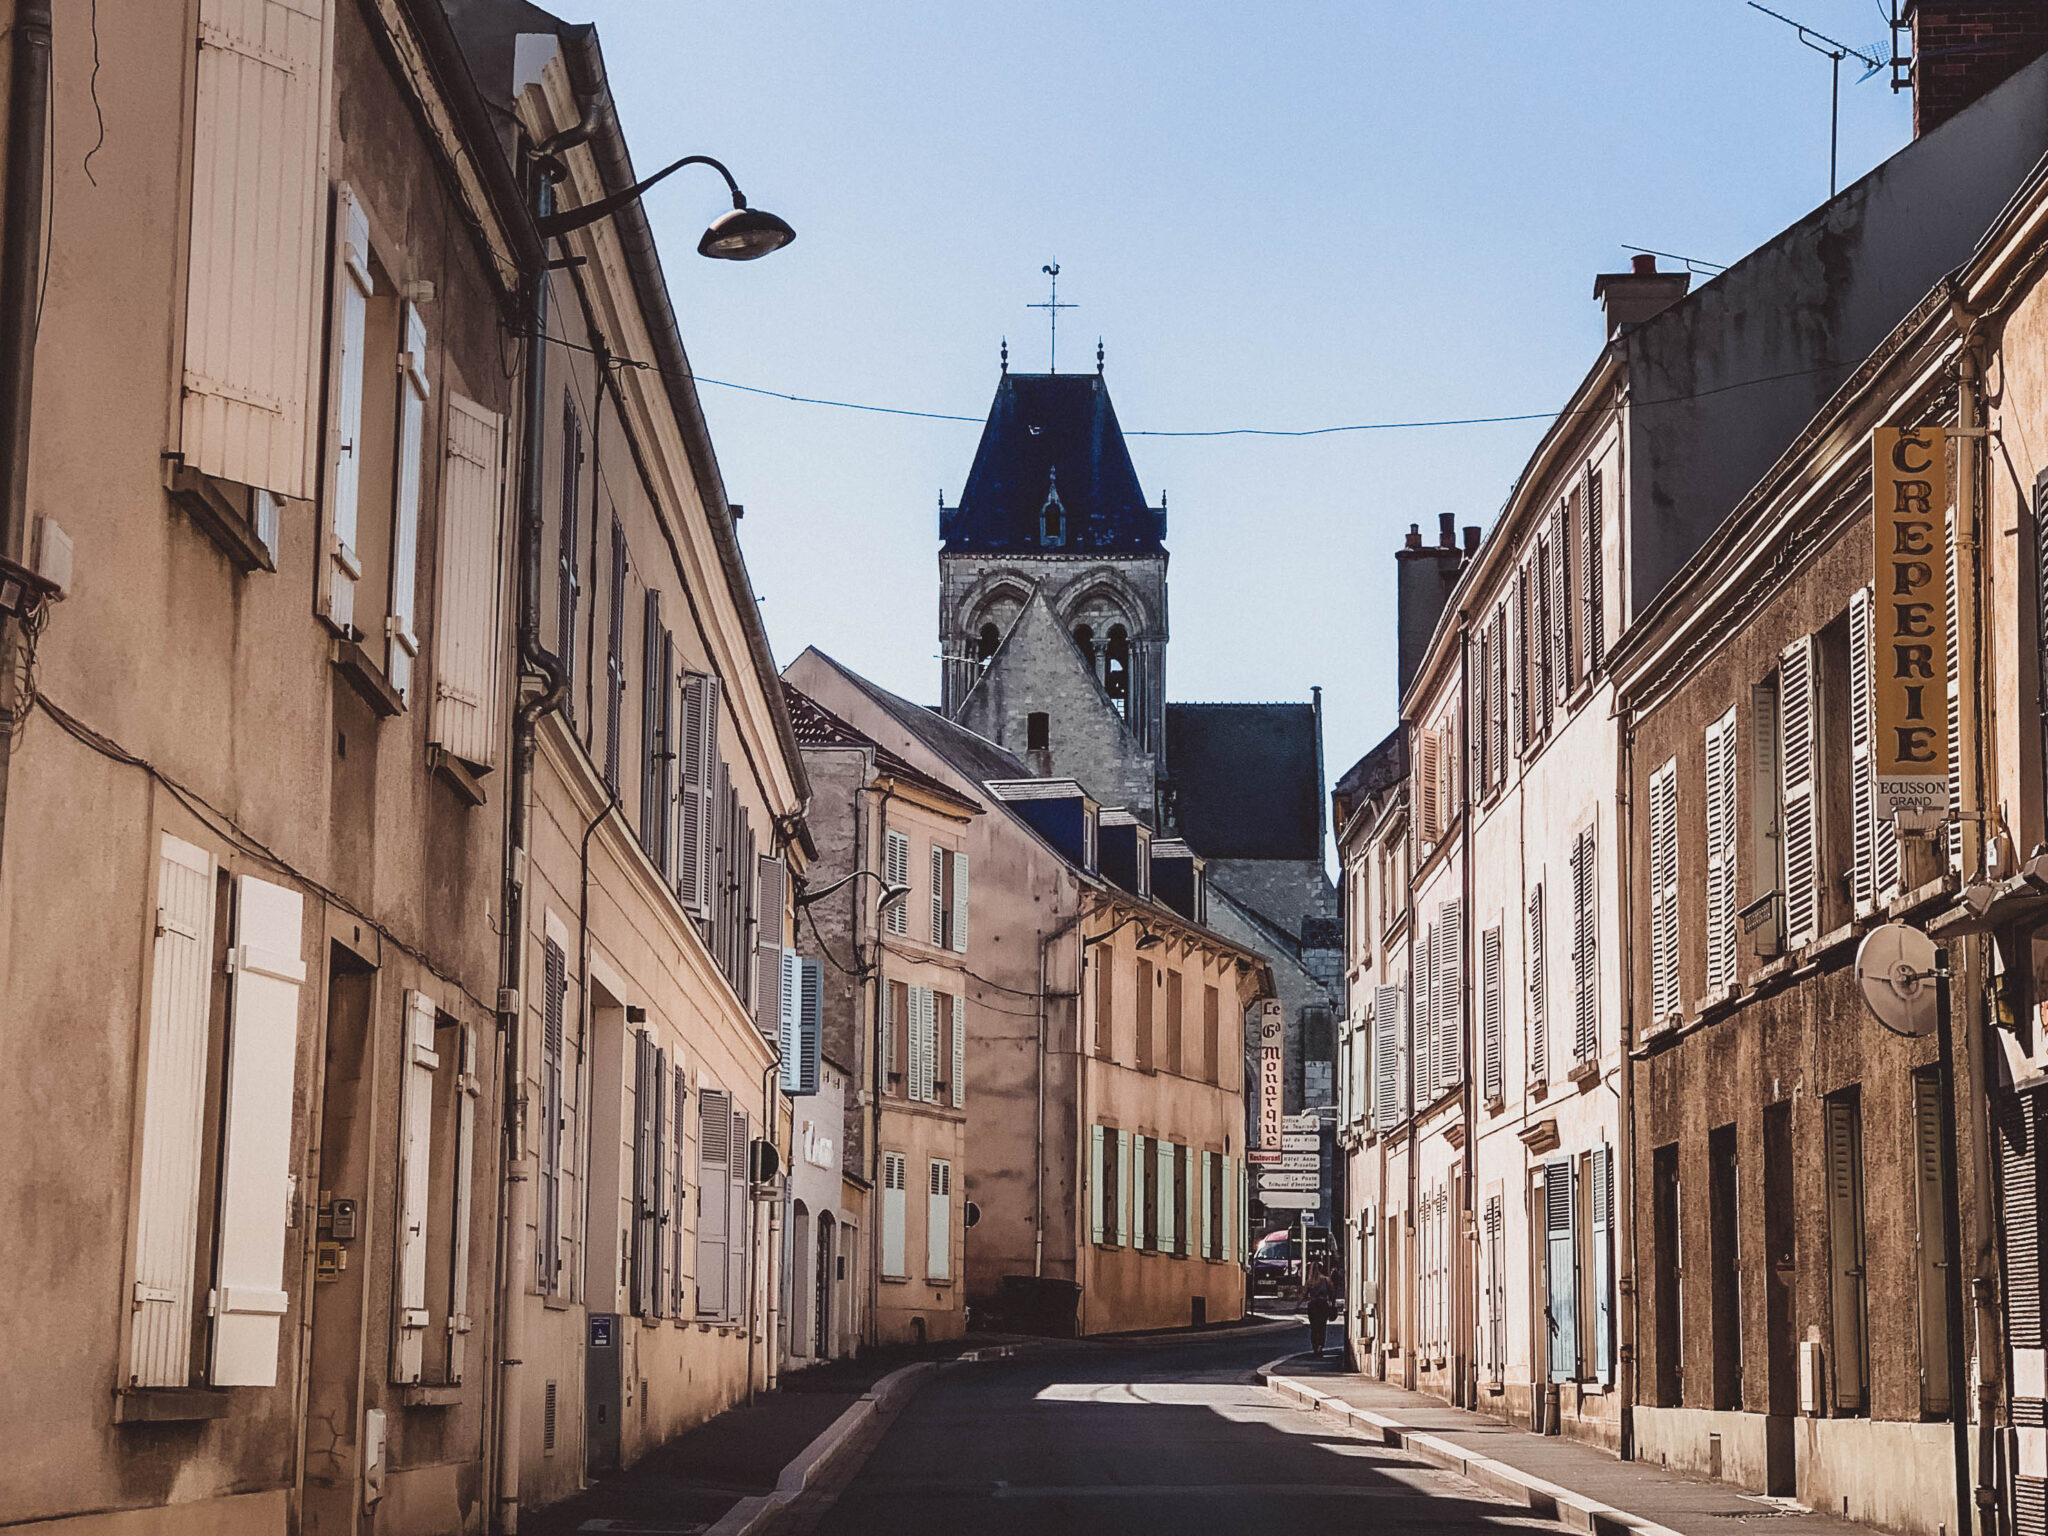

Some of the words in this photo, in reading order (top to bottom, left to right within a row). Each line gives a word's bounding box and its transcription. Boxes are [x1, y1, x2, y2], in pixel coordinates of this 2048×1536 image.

[1892, 437, 1937, 763] CREPERIE
[1880, 781, 1946, 795] ECUSSON
[1889, 796, 1932, 806] GRAND
[1263, 1001, 1280, 1015] Le
[1261, 1046, 1280, 1146] Monarque
[1249, 1153, 1281, 1161] Restaurant
